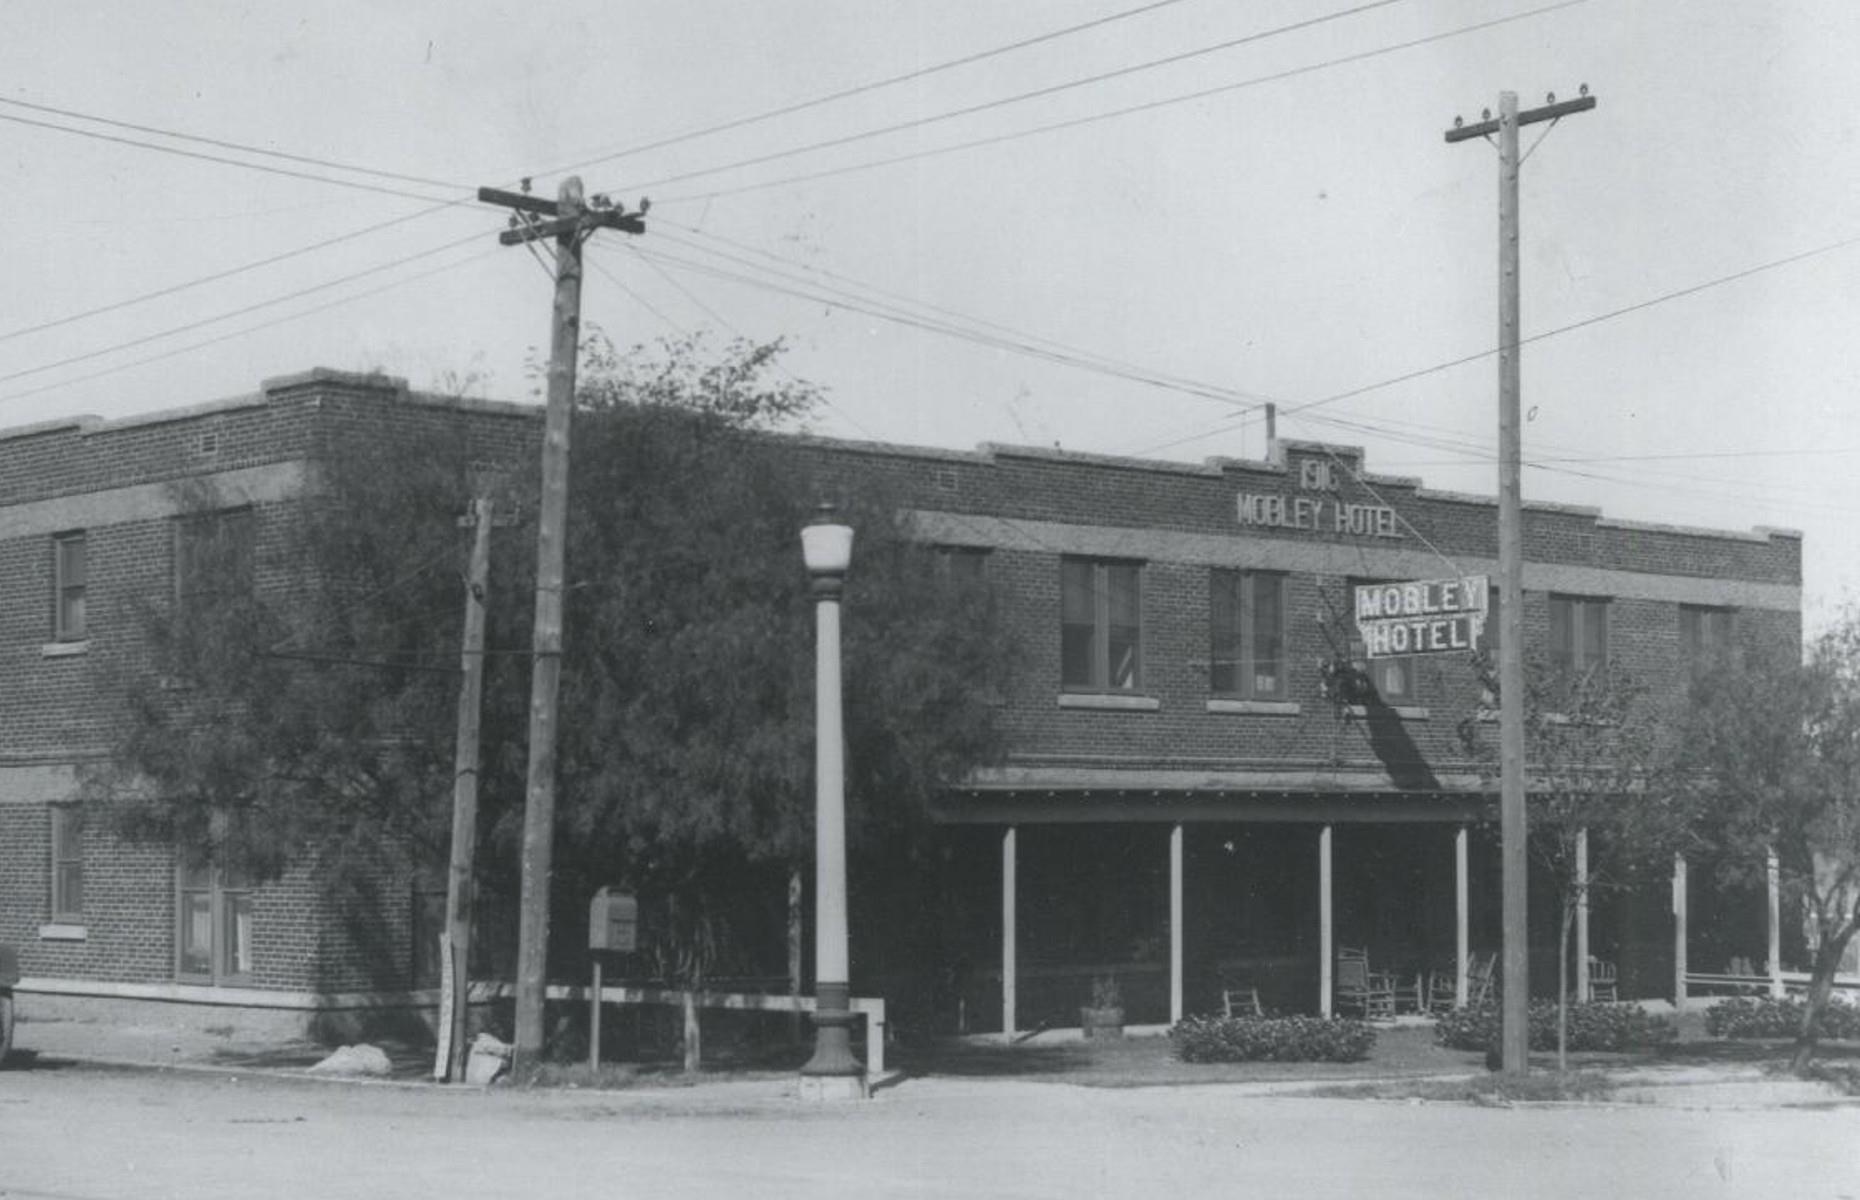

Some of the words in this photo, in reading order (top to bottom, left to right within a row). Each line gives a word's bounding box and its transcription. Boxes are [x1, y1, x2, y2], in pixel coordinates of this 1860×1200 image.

[1301, 459, 1340, 490] 1916
[1237, 493, 1322, 530] MOBLEY
[1335, 502, 1404, 538] HOTEL
[1359, 580, 1480, 616] MOBLEY
[1370, 619, 1468, 654] HOTEL
